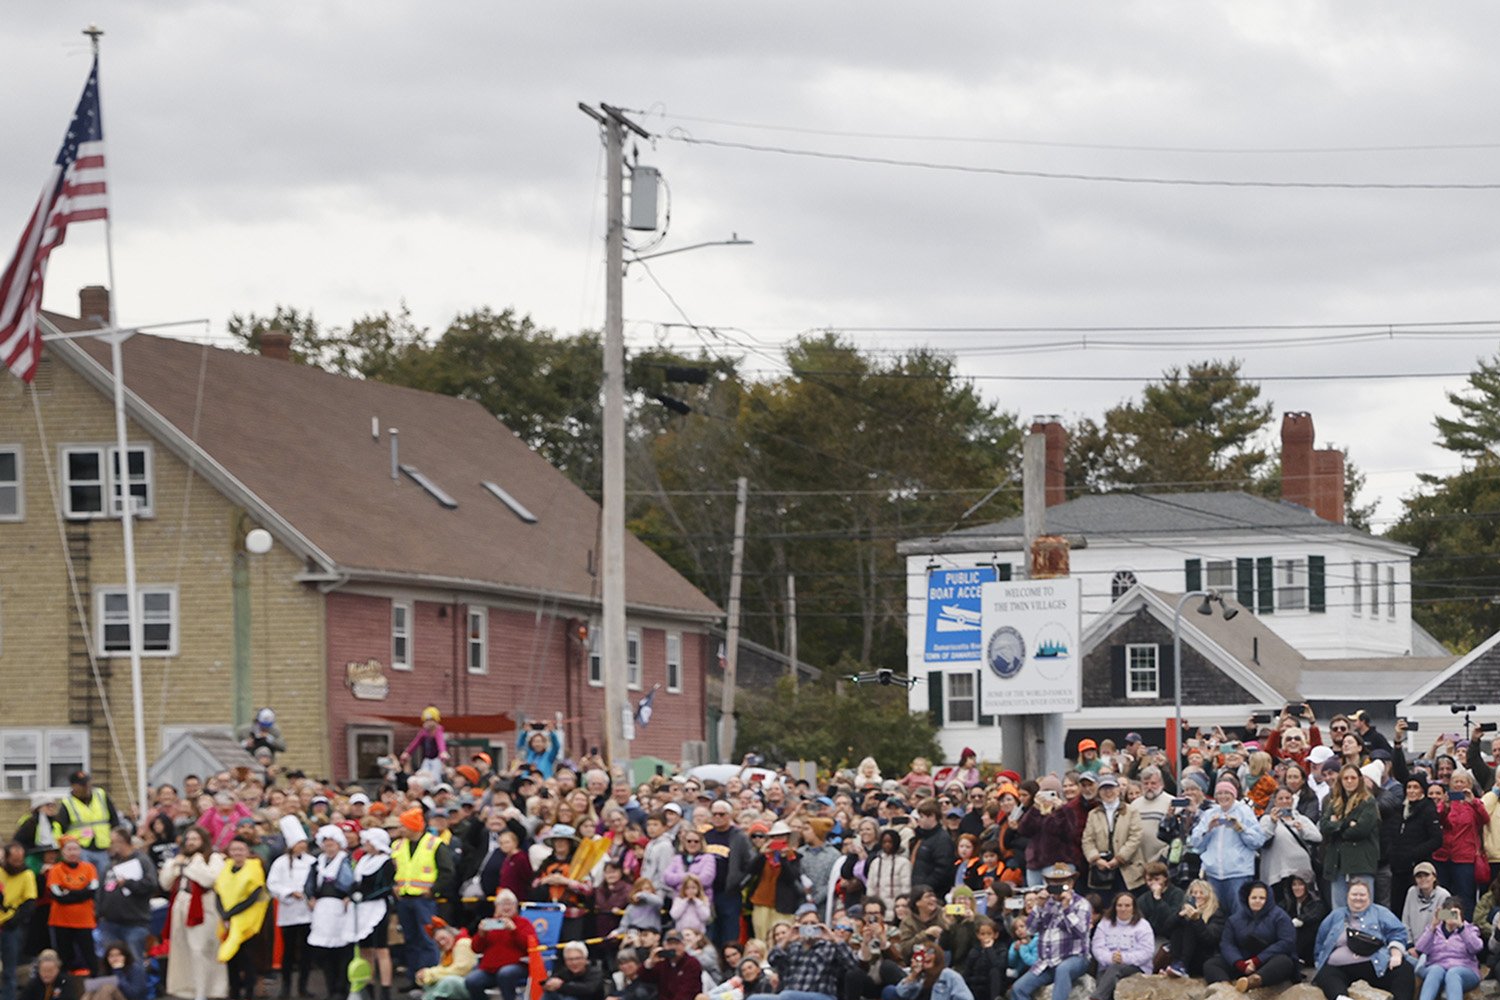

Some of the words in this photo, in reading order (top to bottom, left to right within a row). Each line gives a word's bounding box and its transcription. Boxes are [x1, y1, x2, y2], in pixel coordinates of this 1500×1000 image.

[945, 572, 980, 585] PUBLIC
[929, 587, 954, 600] BOAT
[957, 586, 982, 599] ACCE
[1005, 586, 1041, 598] WELCOME
[1043, 586, 1054, 596] TO
[994, 602, 1008, 612] THE
[1010, 600, 1029, 611] TWIN
[1031, 599, 1067, 610] VILLAGES
